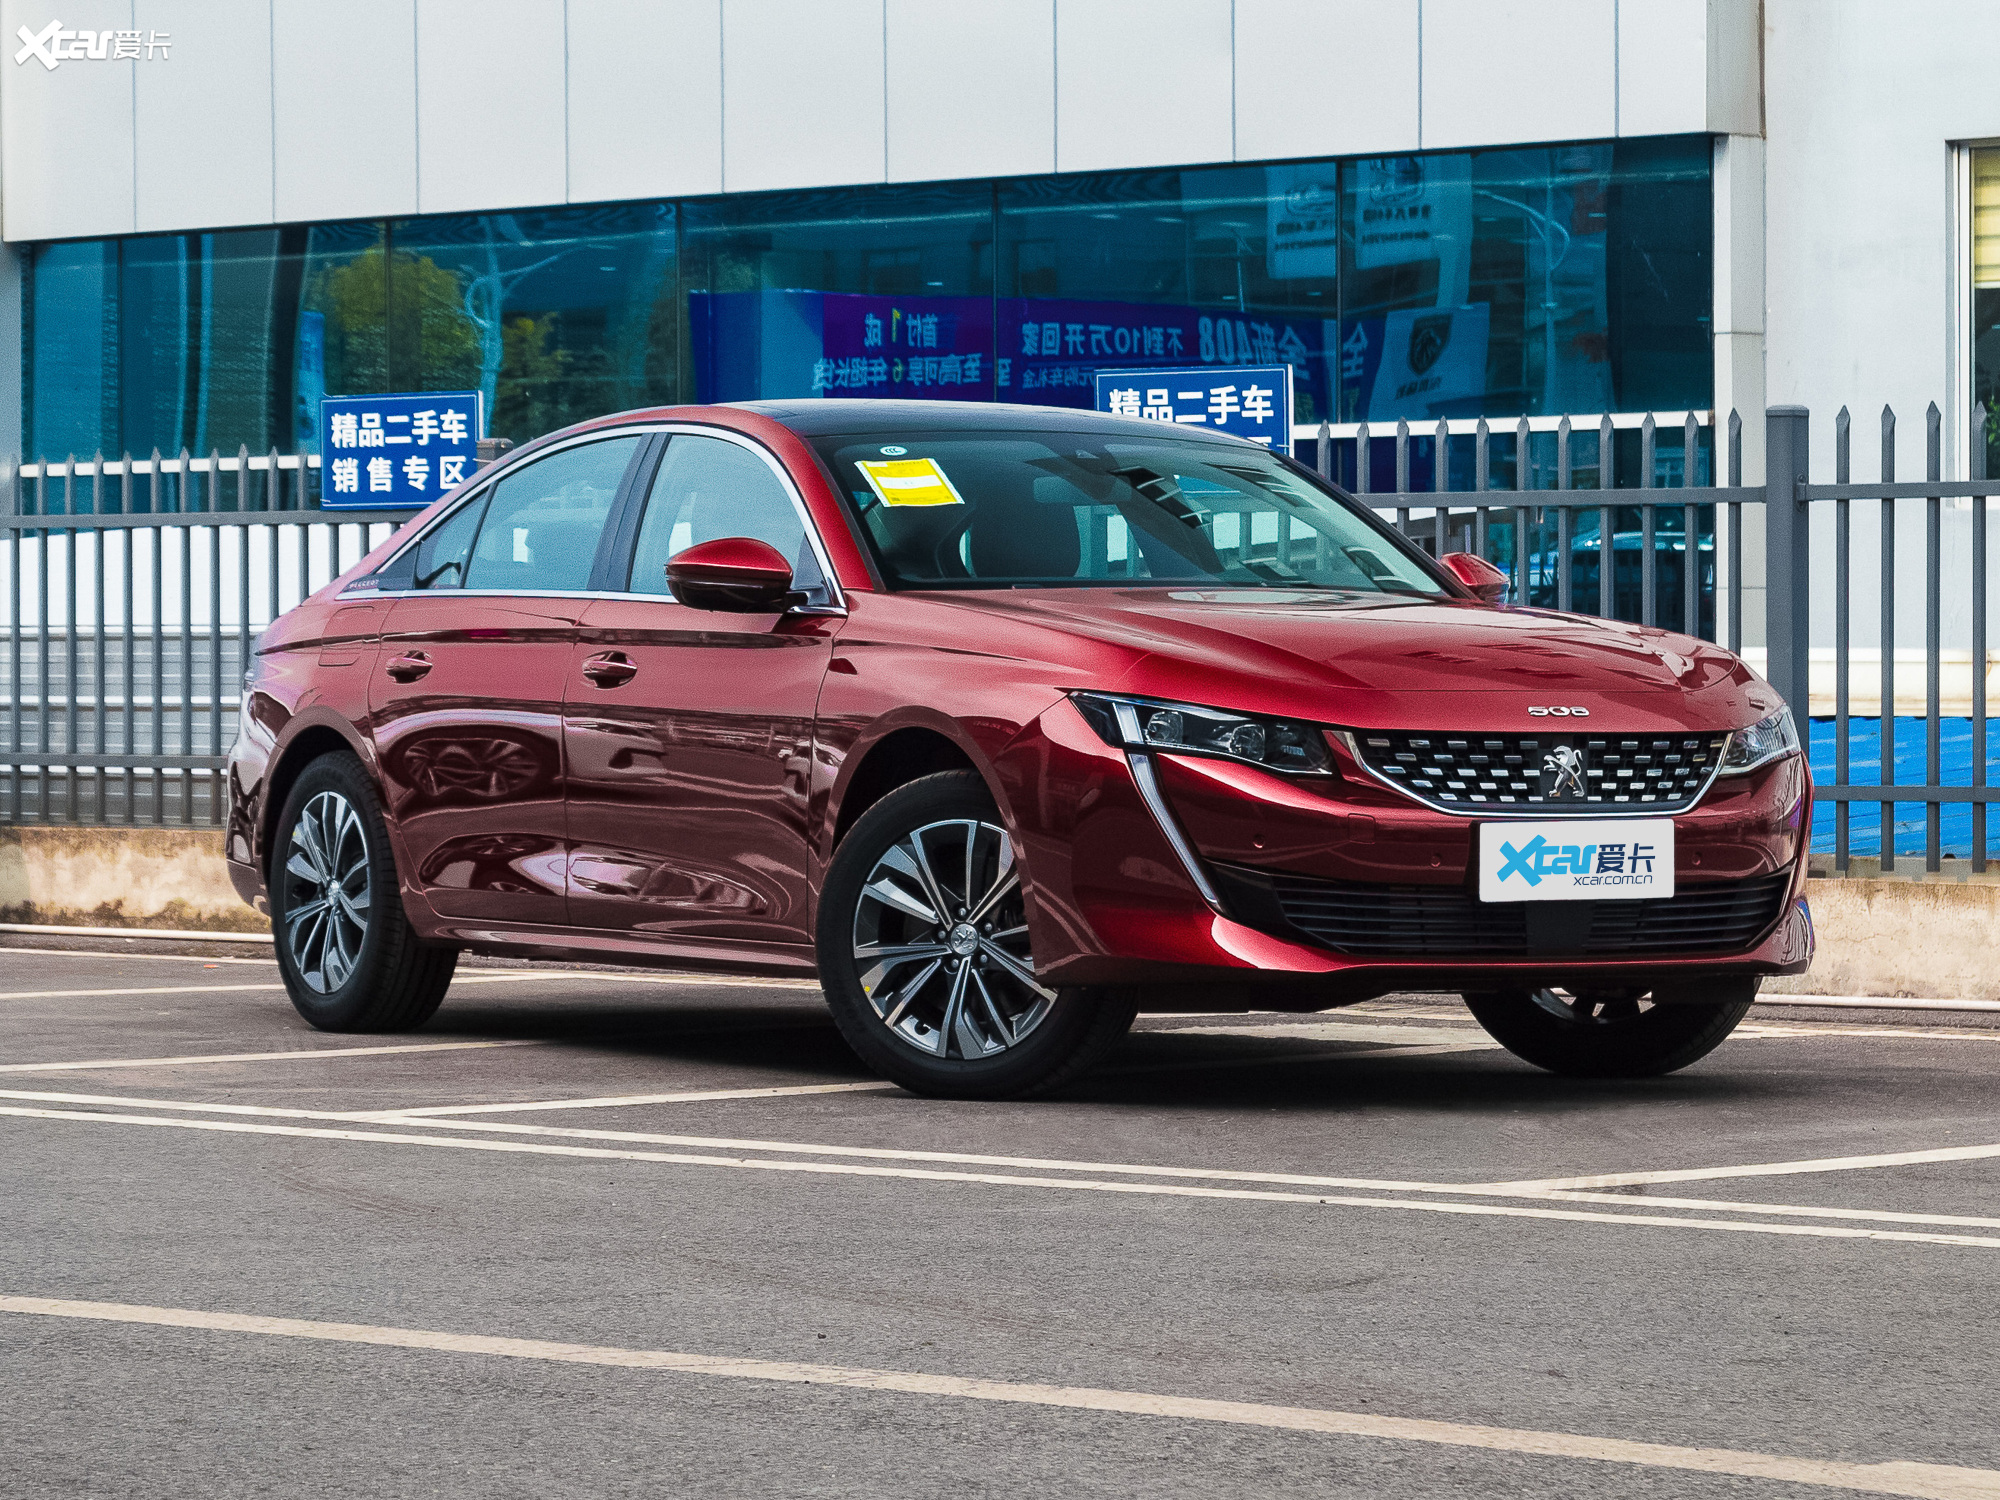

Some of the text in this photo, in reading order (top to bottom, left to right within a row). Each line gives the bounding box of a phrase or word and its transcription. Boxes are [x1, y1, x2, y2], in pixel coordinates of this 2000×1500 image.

[1109, 384, 1274, 424] 精品二手车
[331, 409, 468, 448] 精品二手车
[331, 455, 467, 493] 销售专区
[1527, 706, 1590, 717] 508
[1573, 875, 1653, 886] xcar.com.cn
